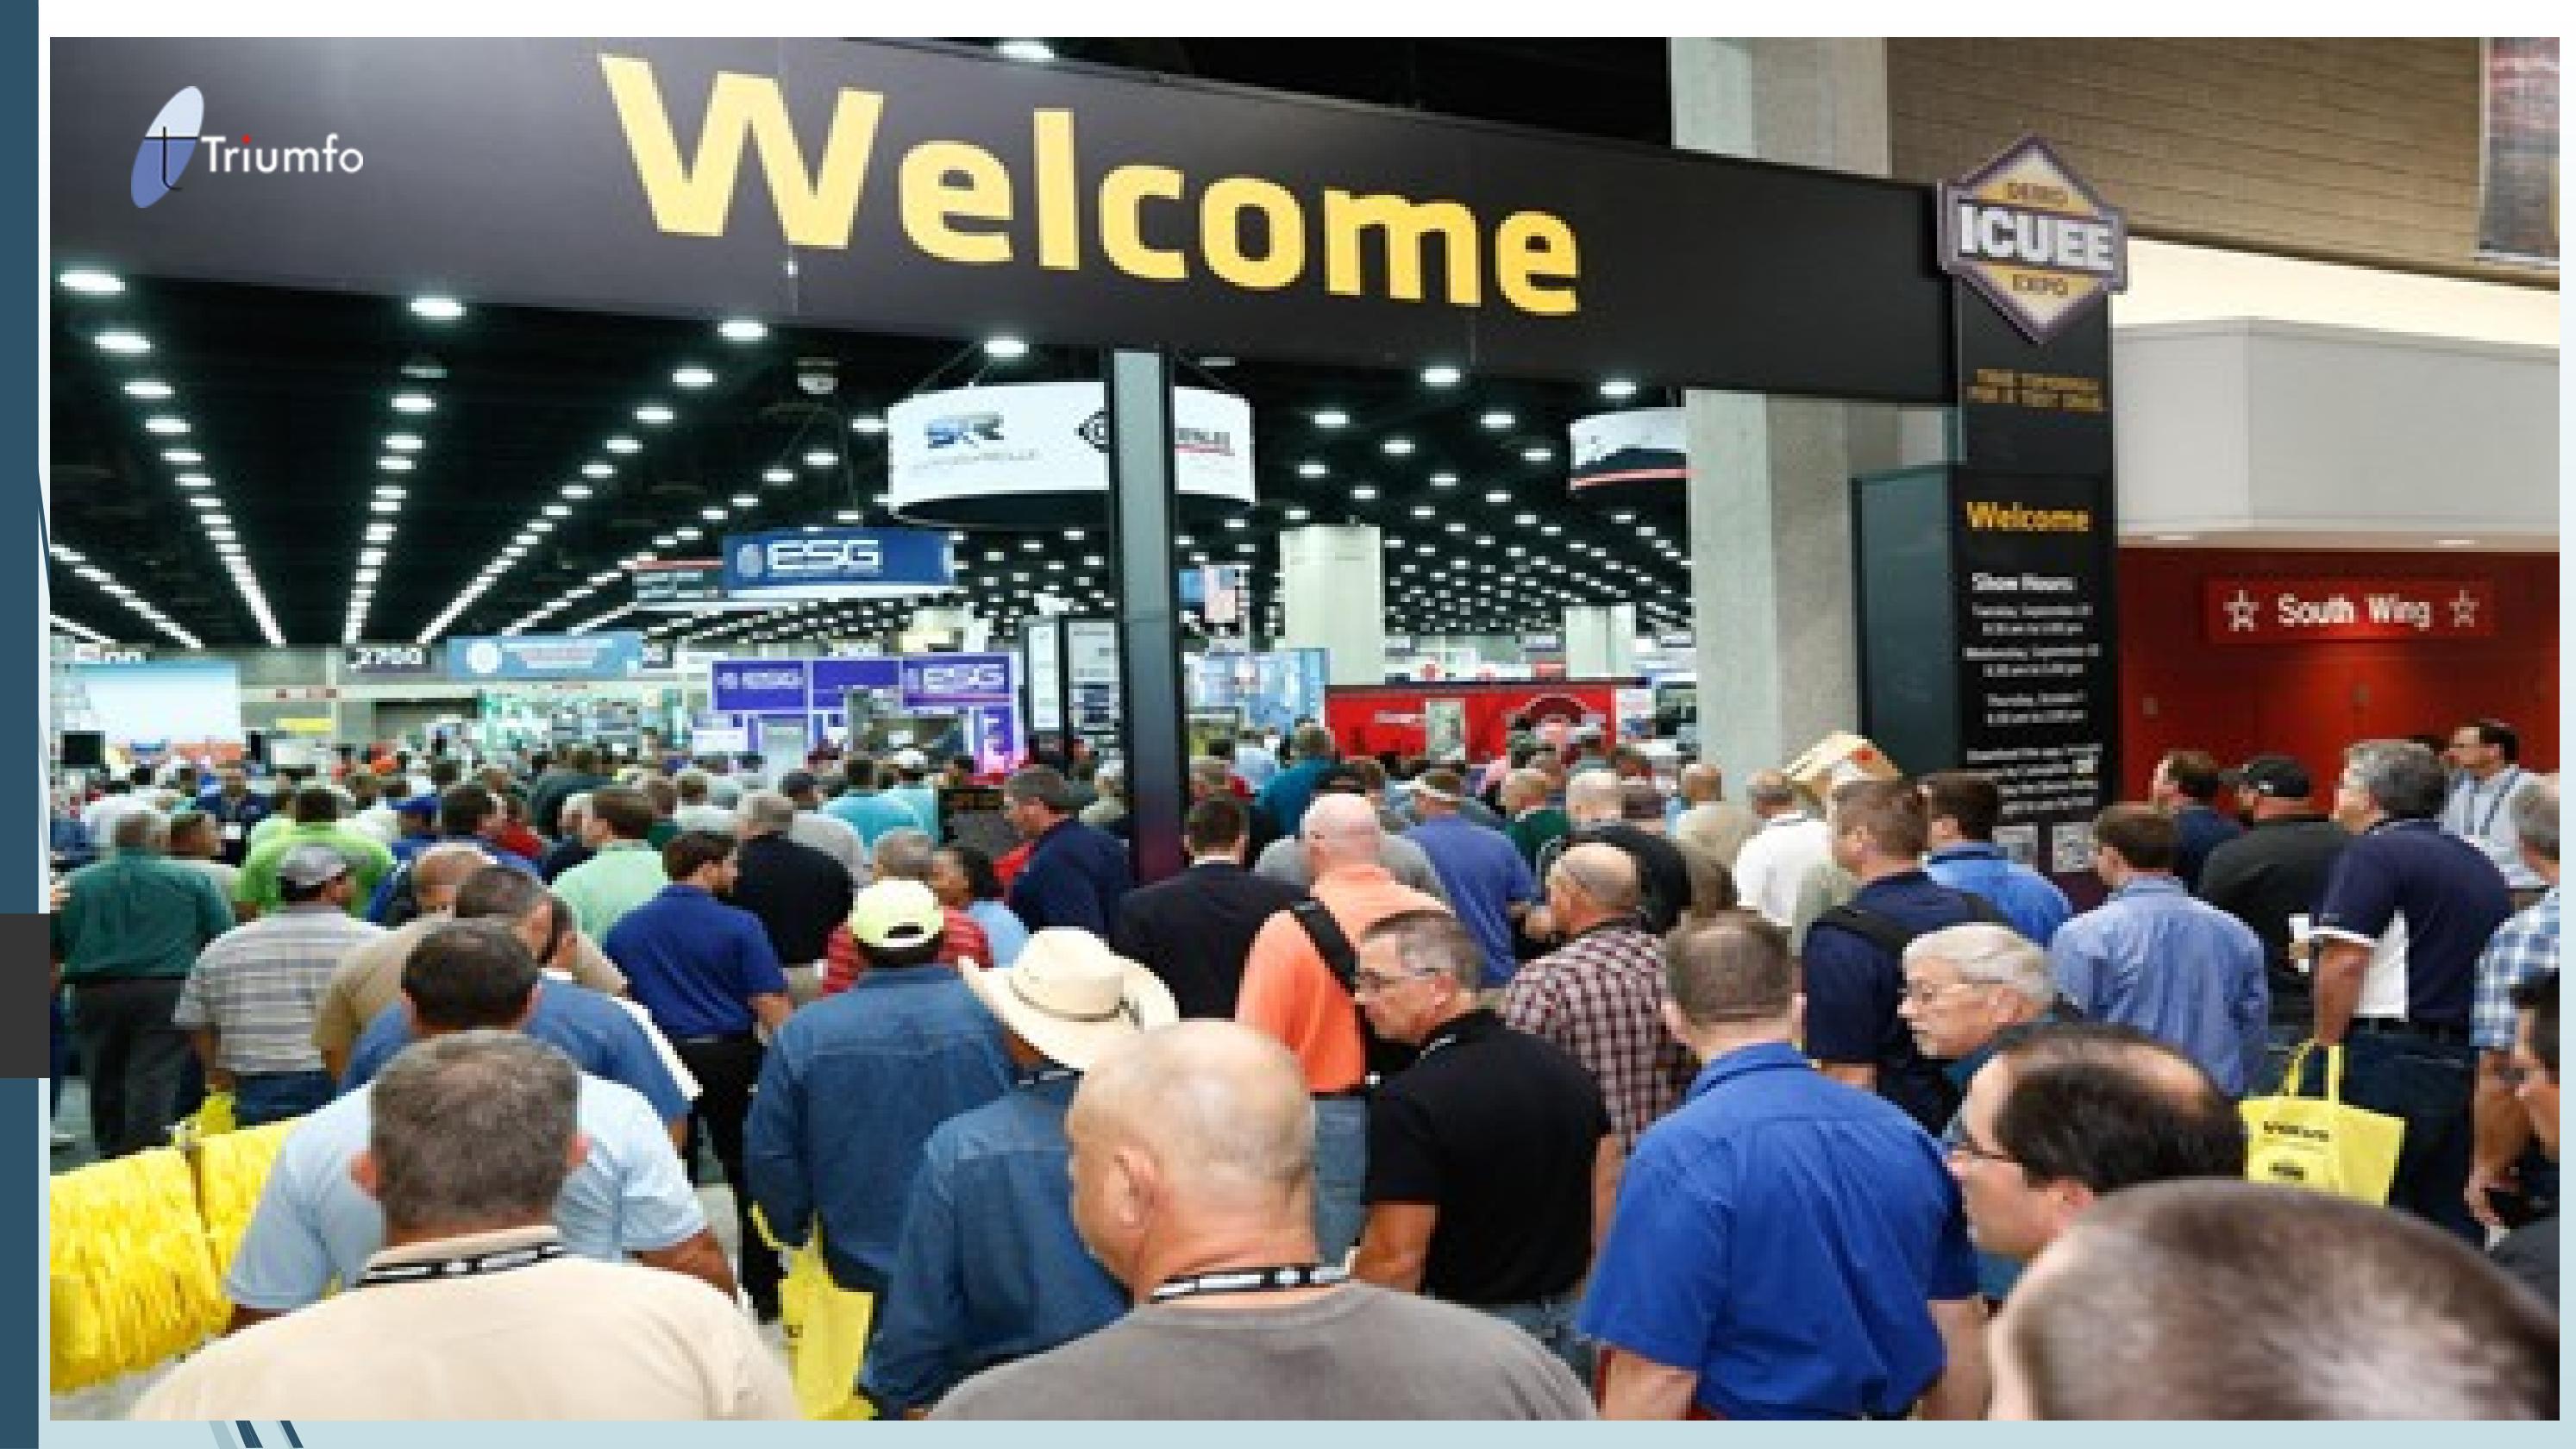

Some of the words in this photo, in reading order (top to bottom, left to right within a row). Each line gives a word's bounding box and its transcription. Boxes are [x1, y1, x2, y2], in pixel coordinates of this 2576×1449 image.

[598, 53, 1581, 316] Welcome
[1960, 205, 2114, 271] ICUEE
[2012, 273, 2069, 296] EXPO
[1966, 500, 2090, 532] Welcome
[766, 538, 883, 573] ESG
[1971, 572, 2018, 593] Show
[2278, 593, 2355, 627] South
[2364, 593, 2433, 630] Wing
[922, 662, 1006, 694] ESG
